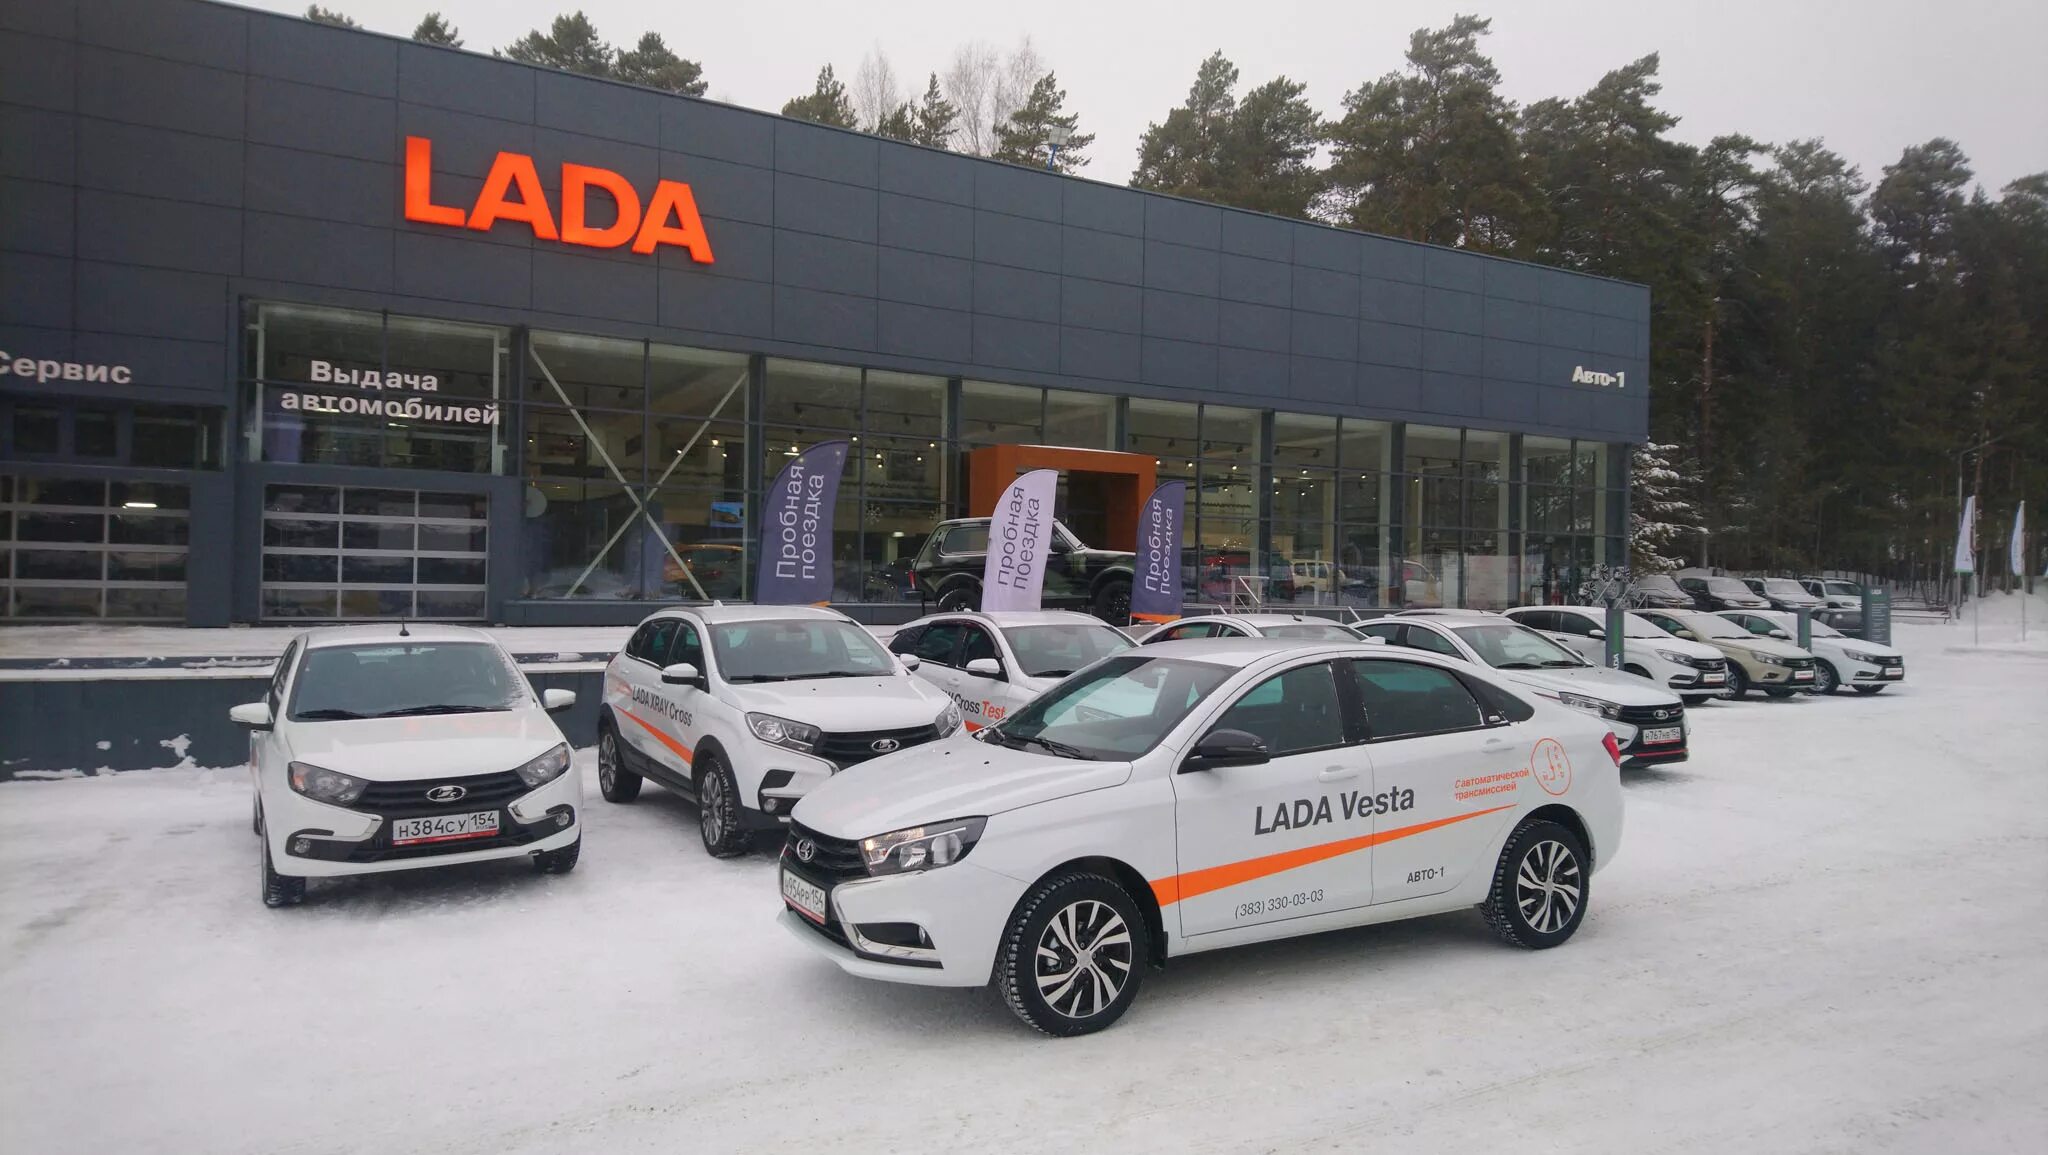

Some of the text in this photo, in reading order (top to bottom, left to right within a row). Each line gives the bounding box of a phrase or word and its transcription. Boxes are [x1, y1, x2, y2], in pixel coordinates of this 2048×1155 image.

[405, 135, 715, 264] LADA
[310, 360, 438, 391] Выдача
[281, 392, 500, 425] автомобилей
[776, 465, 805, 579] Пробная
[802, 474, 825, 579] поездка
[1145, 498, 1162, 591] Пробная
[632, 685, 693, 727] LADA XRAY Cross
[982, 700, 1006, 719] Test
[1455, 782, 1517, 801] трансмиссией
[1461, 767, 1530, 788] автоматической
[470, 812, 495, 826] 154
[1254, 785, 1415, 836] LADA Vesta
[1406, 866, 1445, 884] АВТО-1
[1234, 889, 1324, 920] (383) 330-03-03
